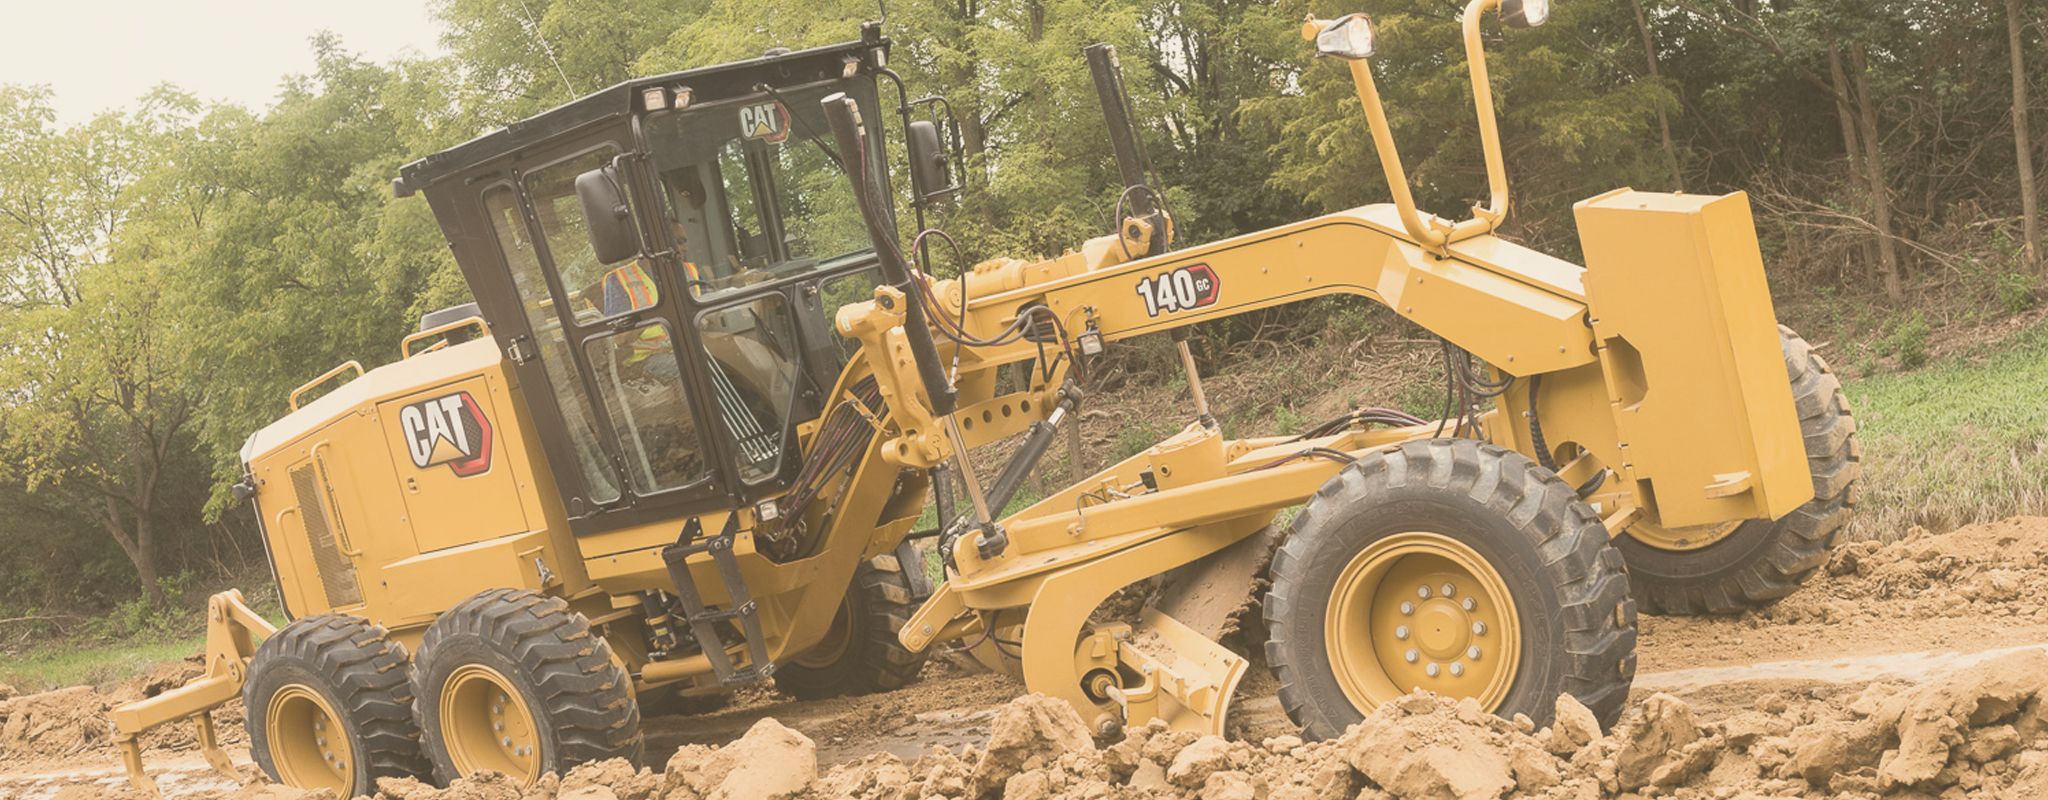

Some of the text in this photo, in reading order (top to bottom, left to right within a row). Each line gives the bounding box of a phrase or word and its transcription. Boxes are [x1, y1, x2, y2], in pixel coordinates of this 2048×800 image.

[740, 103, 777, 137] CAT
[1137, 269, 1210, 316] 140 GC
[401, 394, 471, 467] CAT
